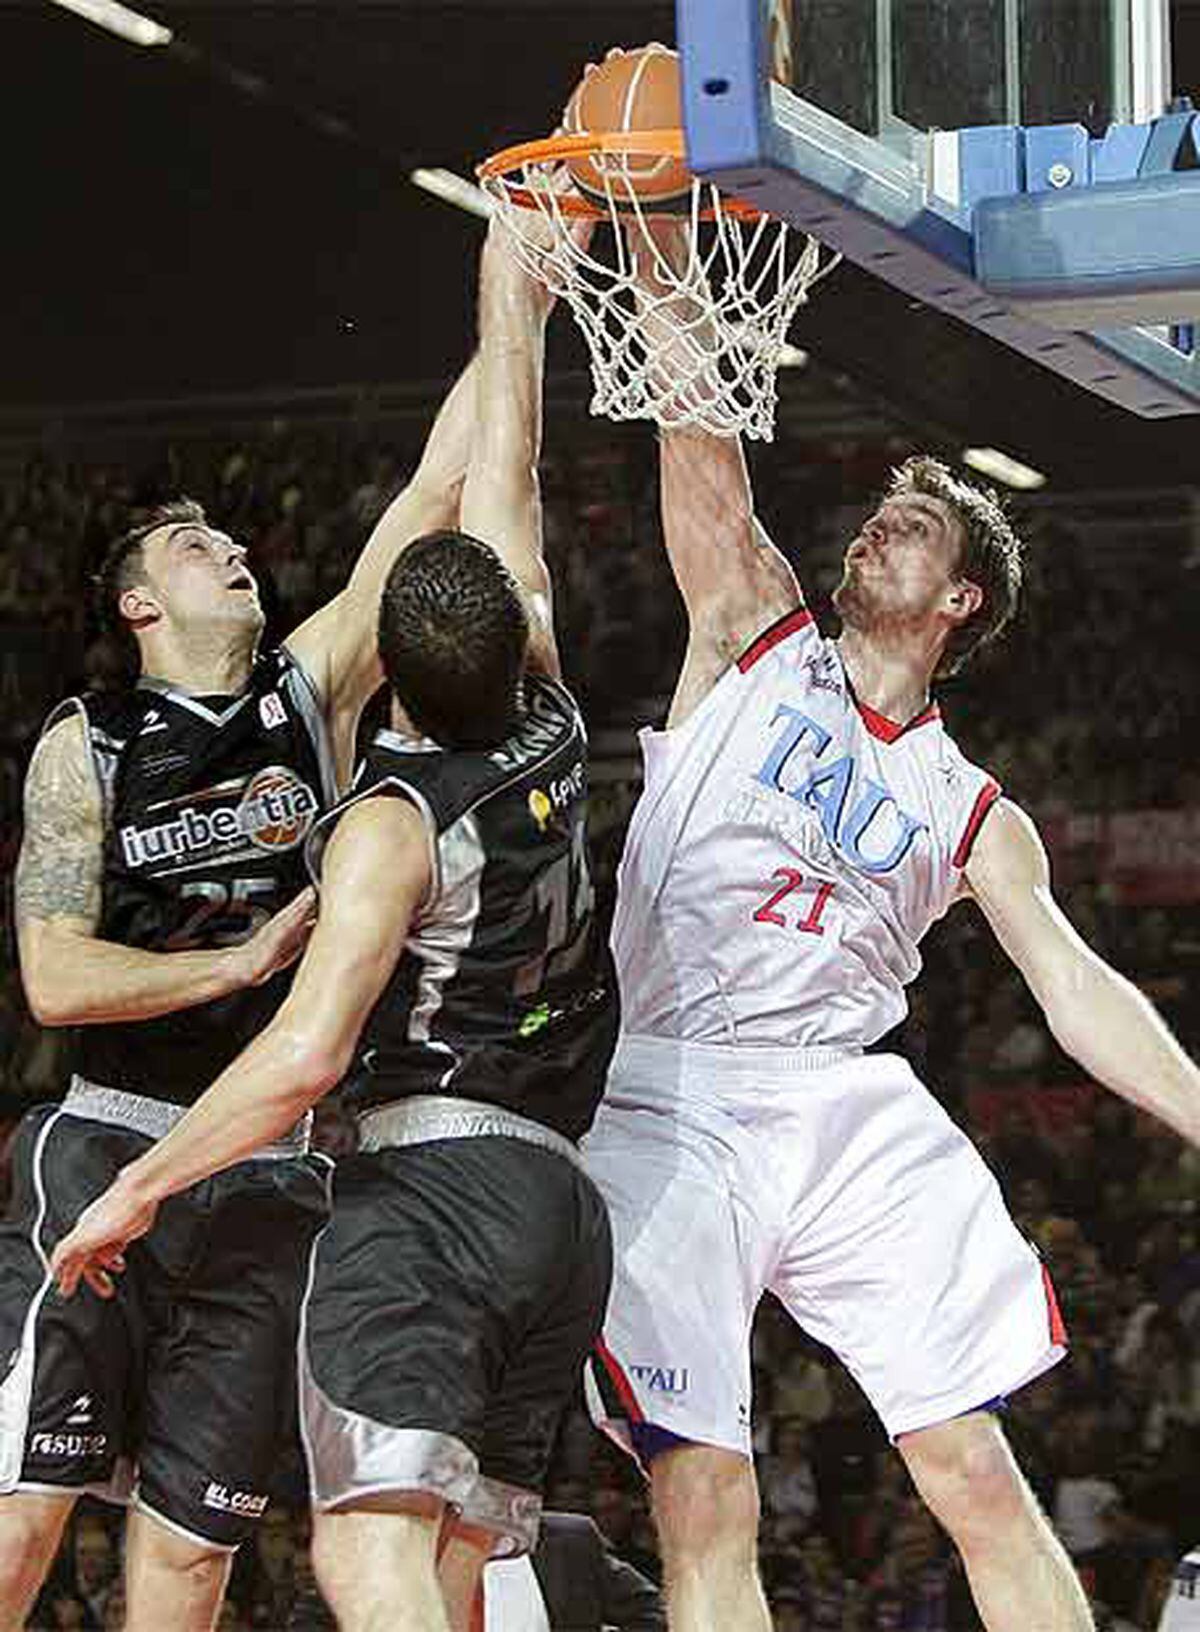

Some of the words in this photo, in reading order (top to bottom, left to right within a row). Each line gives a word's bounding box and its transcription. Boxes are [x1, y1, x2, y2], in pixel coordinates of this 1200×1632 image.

[759, 703, 930, 874] TAU
[753, 867, 836, 935] 21
[630, 1365, 689, 1393] TAU
